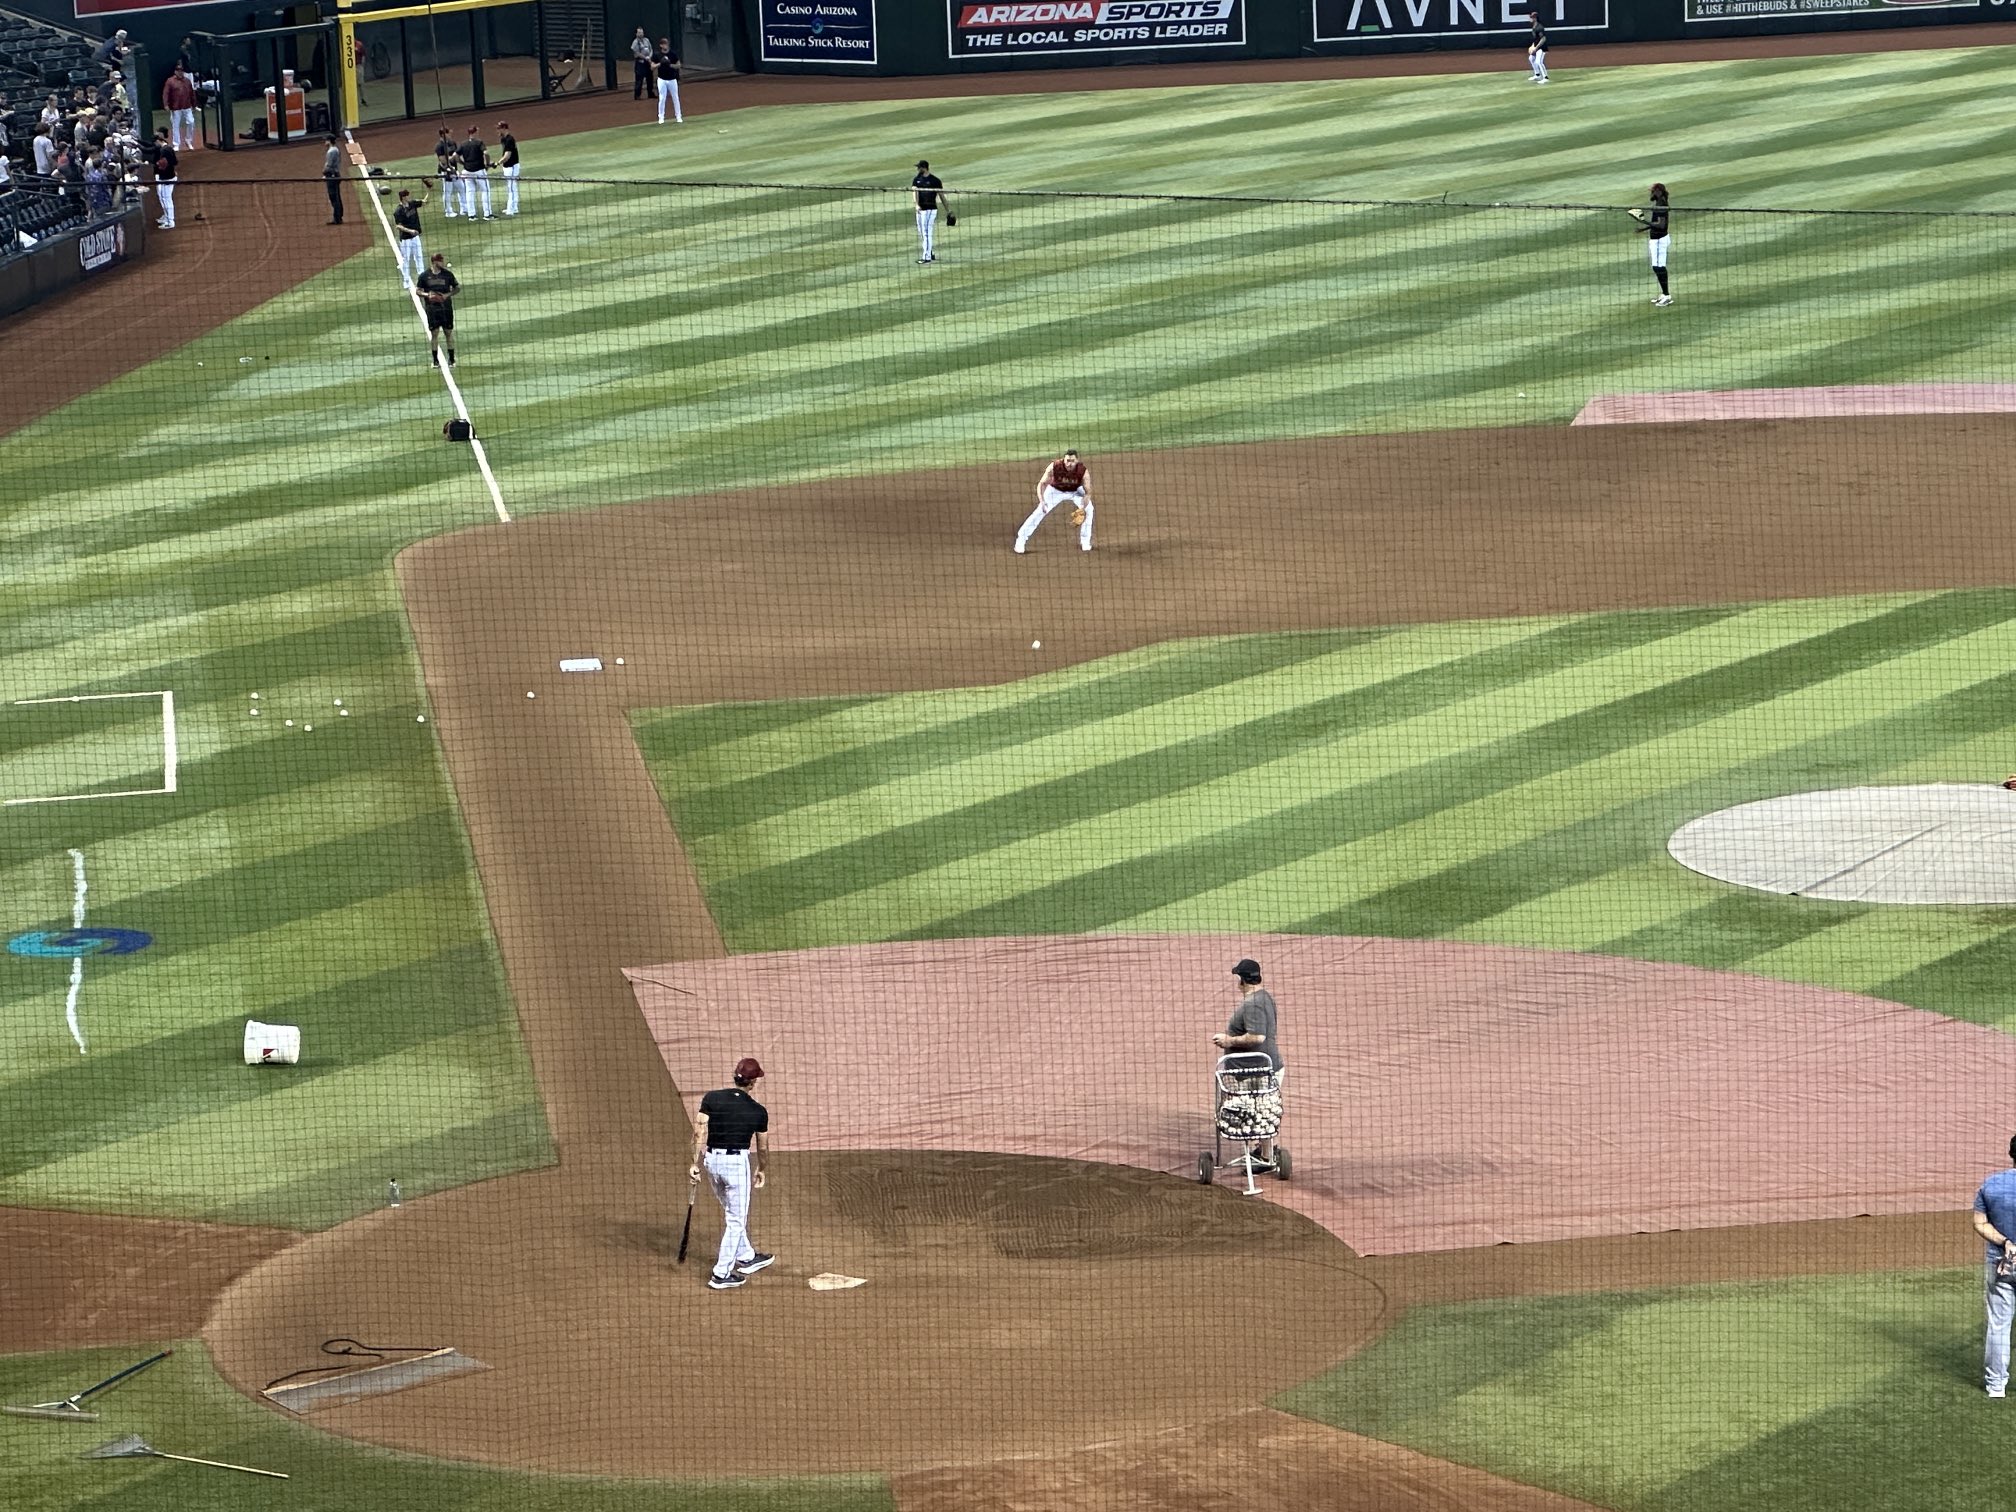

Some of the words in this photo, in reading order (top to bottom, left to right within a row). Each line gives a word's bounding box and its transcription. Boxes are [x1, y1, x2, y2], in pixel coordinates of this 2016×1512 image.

[776, 2, 812, 14] CASINO
[814, 3, 857, 16] ARIZONA
[966, 2, 1094, 25] ARIZONA
[1105, 1, 1221, 21] SPORTS
[1706, 3, 1723, 15] USE
[767, 35, 806, 47] TALKING
[807, 35, 834, 48] STICK
[834, 36, 870, 49] RESORT
[965, 33, 1003, 47] THE
[1006, 30, 1069, 45] LOCAL
[1073, 26, 1150, 42] SPORTS
[1154, 23, 1228, 38] LEADER
[345, 34, 354, 69] 330
